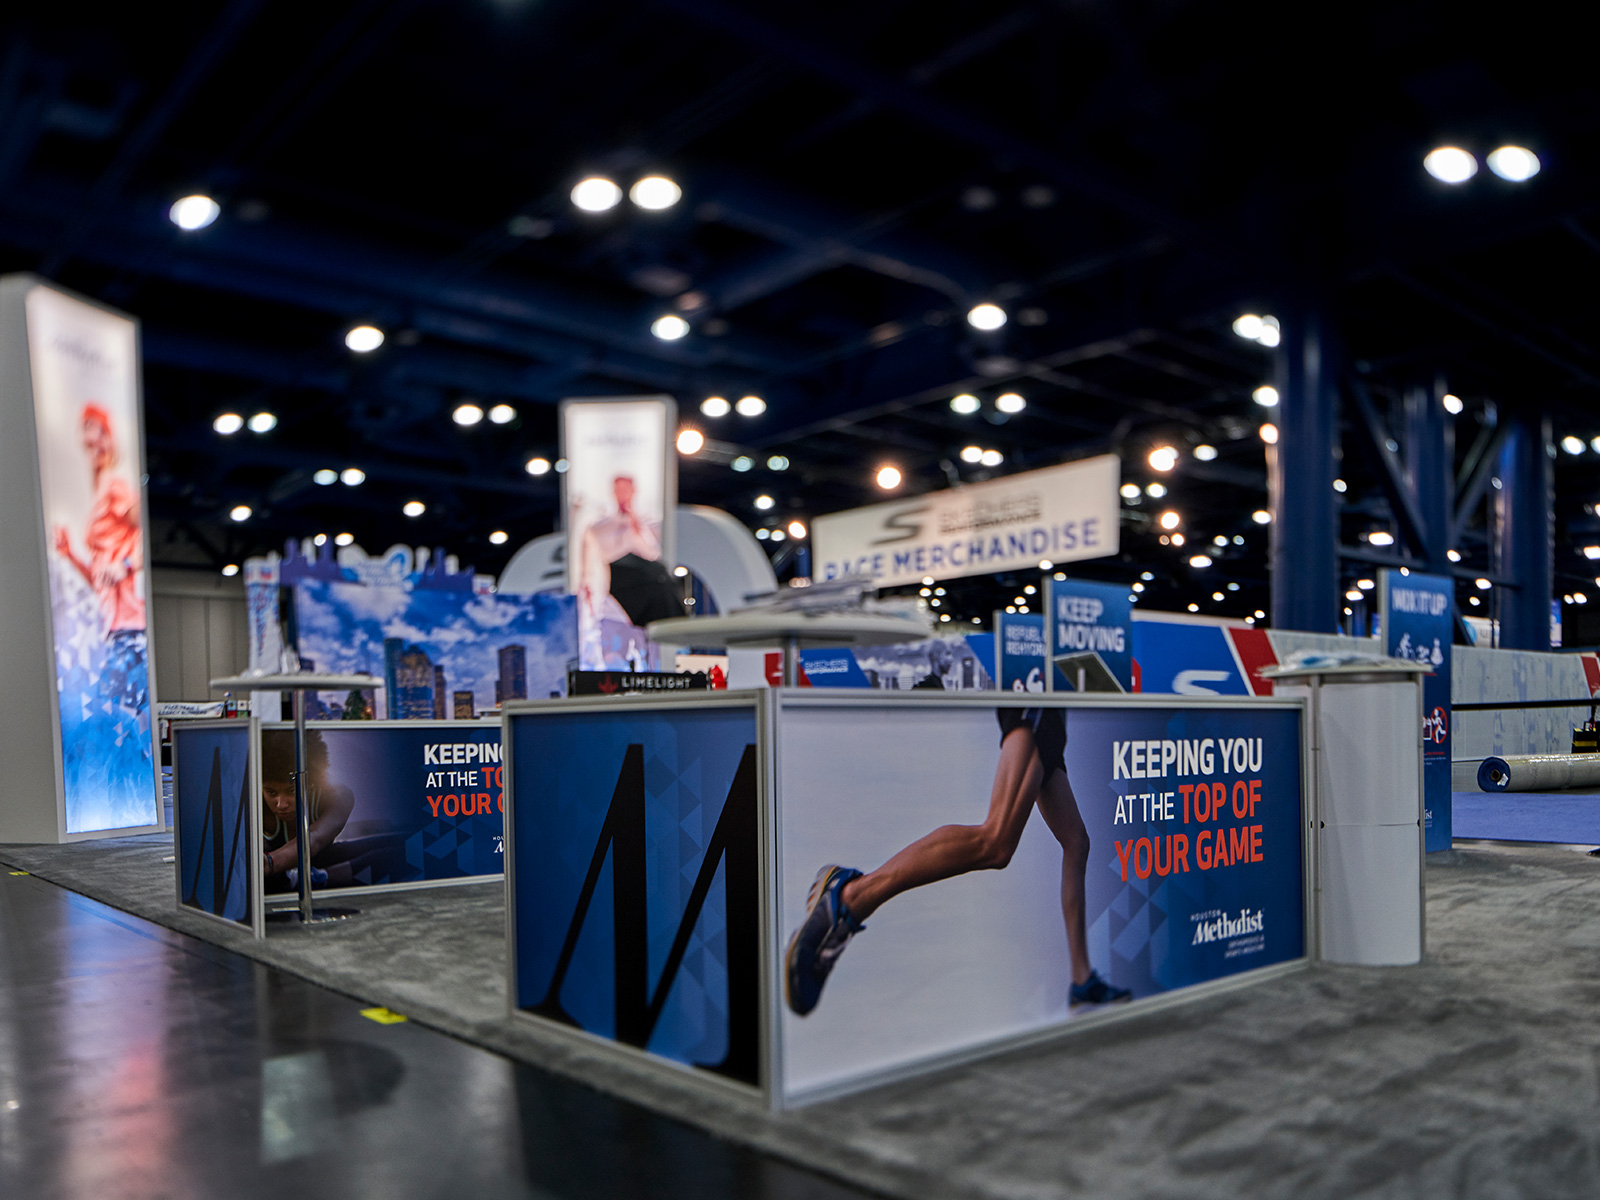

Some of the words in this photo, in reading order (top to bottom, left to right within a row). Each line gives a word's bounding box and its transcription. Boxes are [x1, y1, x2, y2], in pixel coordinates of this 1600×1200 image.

[891, 516, 1100, 575] MERCHANDISE
[1057, 595, 1104, 624] KEEP
[1058, 623, 1126, 653] MOVING
[621, 676, 692, 689] LIMELIGHT
[1112, 738, 1215, 780] KEEPING
[1218, 737, 1263, 774] YOU
[425, 771, 445, 789] AT
[447, 770, 478, 787] THE
[426, 793, 492, 818] YOUR
[1114, 794, 1137, 825] AT
[1139, 792, 1175, 822] THE
[1178, 781, 1228, 824] TOP
[1232, 779, 1263, 819] OF
[1113, 833, 1190, 882] YOUR
[1196, 824, 1264, 871] GAME
[1191, 908, 1264, 946] Methodist
